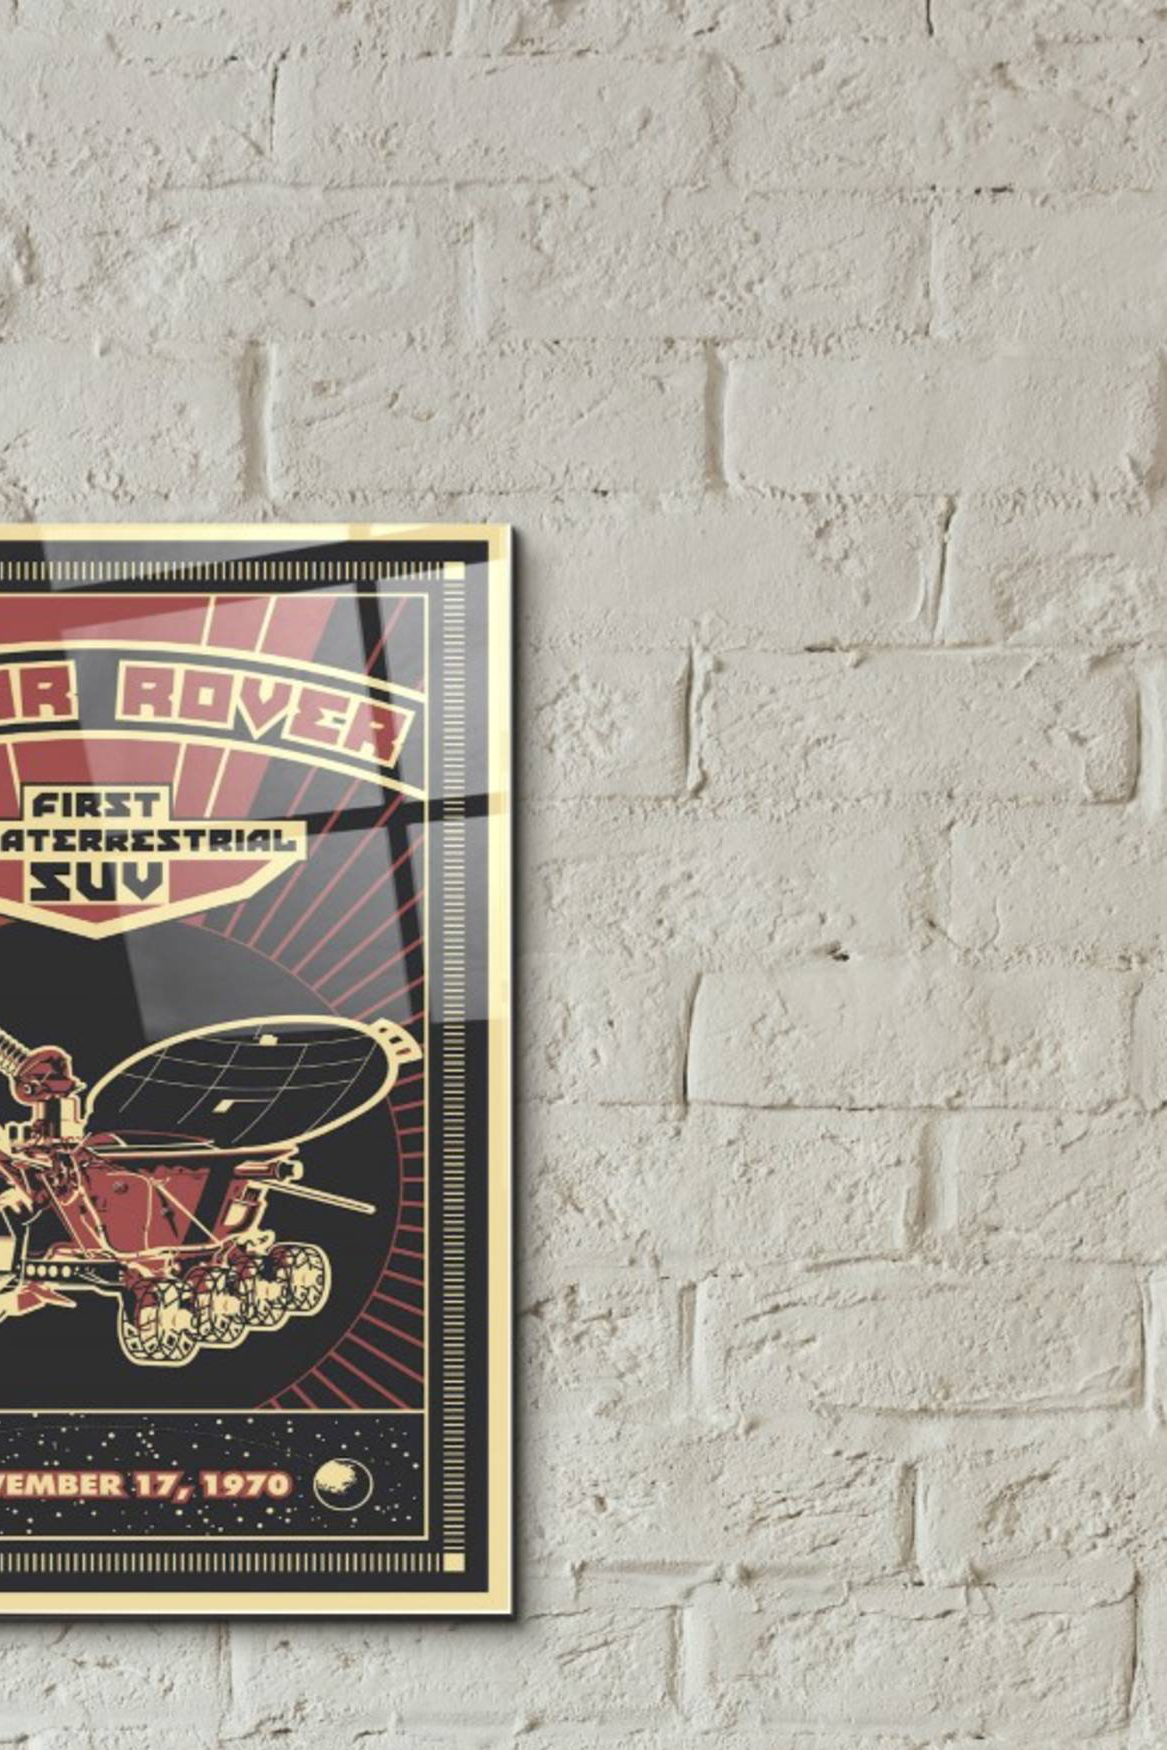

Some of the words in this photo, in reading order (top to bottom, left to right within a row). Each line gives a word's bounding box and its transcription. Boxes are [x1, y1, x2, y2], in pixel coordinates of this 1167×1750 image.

[117, 661, 413, 767] ROVER
[32, 792, 161, 818] FIRST
[29, 861, 165, 902] SUV
[135, 1472, 191, 1501] 17,
[203, 1472, 291, 1497] 1970
